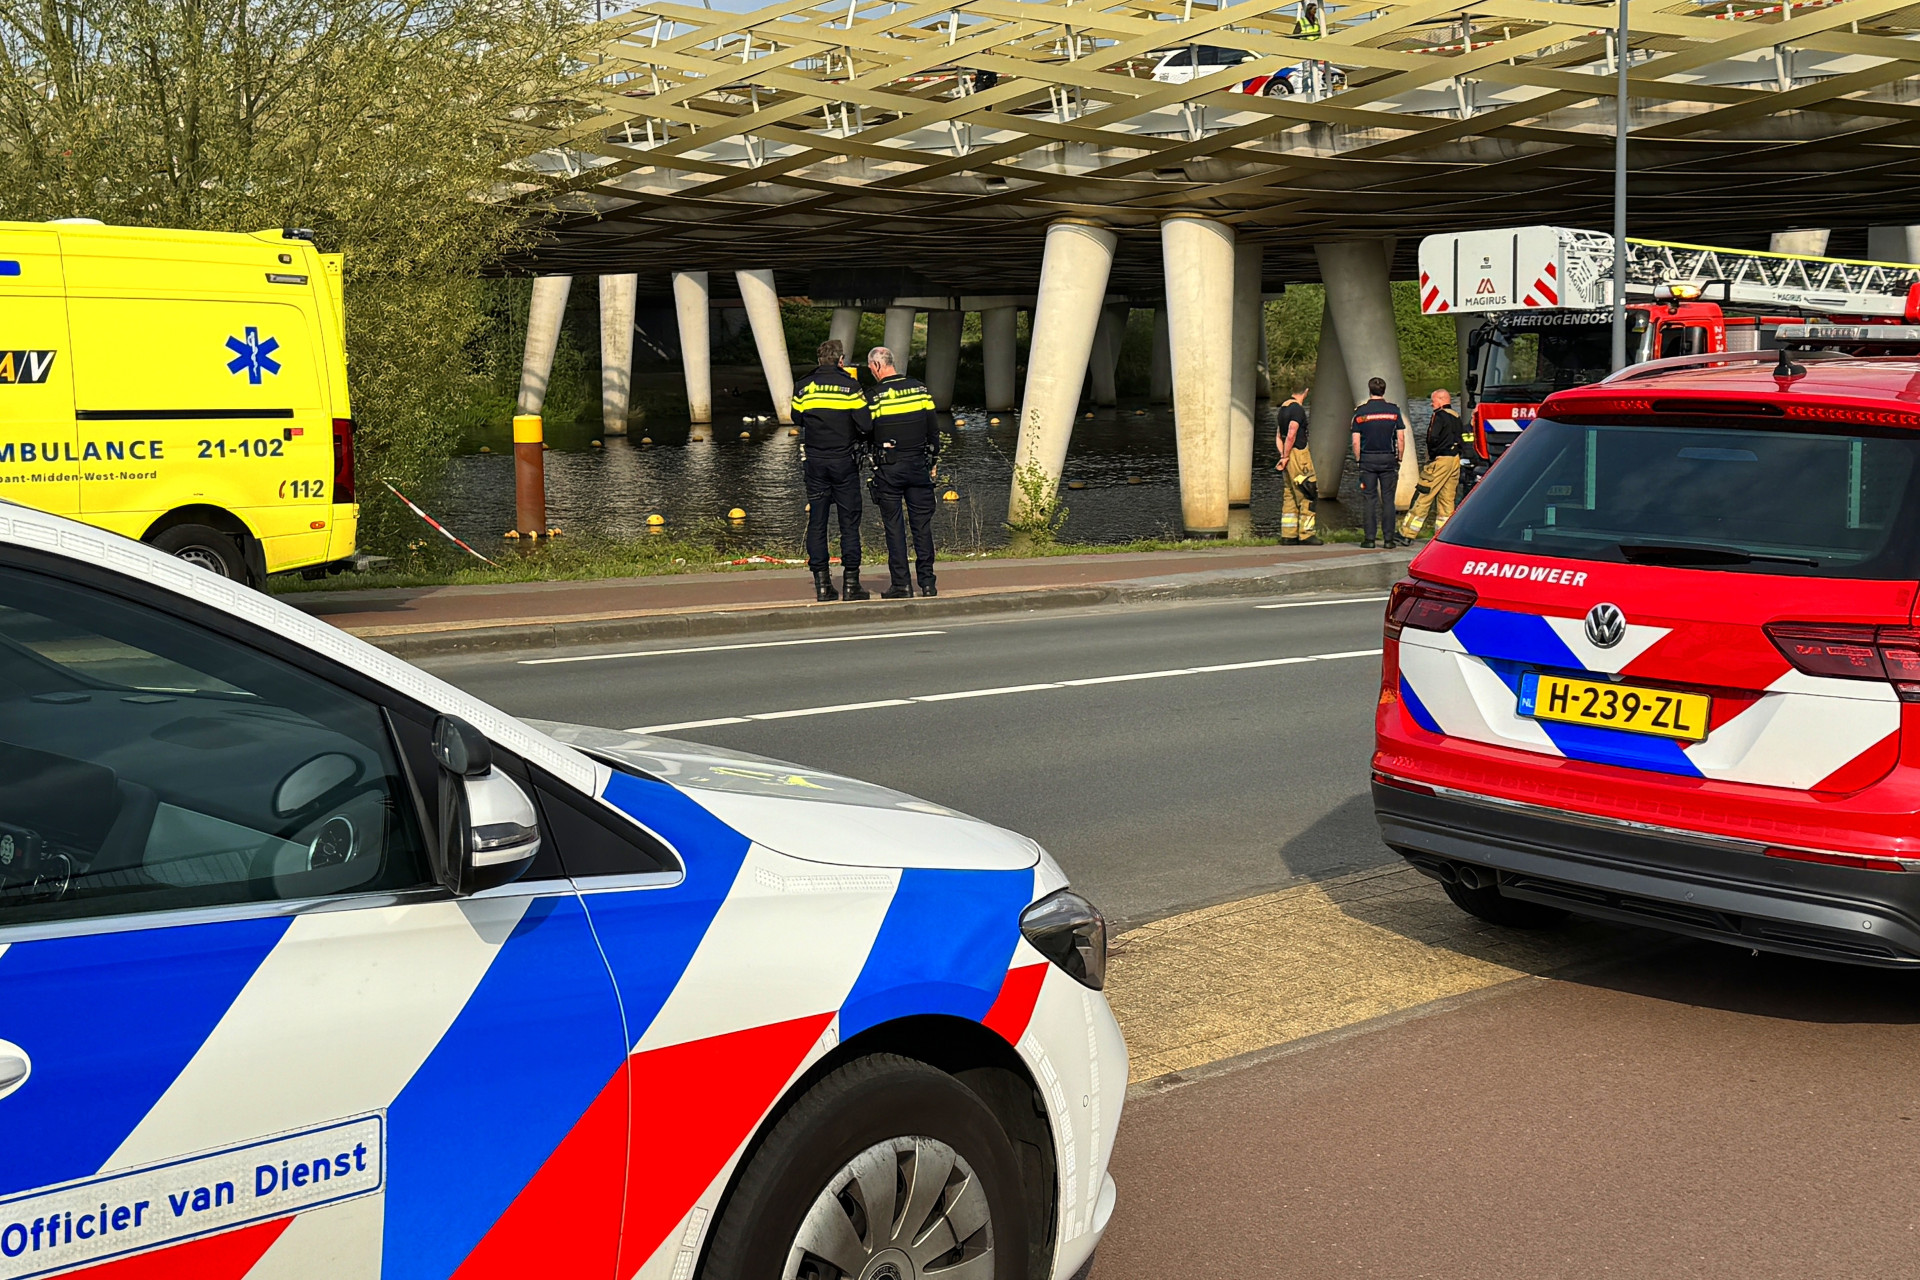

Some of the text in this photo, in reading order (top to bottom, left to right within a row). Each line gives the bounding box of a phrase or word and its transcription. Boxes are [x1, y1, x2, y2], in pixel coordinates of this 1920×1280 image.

[1465, 295, 1507, 307] MAGIRUS
[1500, 311, 1628, 328] 's-HERTOGENBOSC
[197, 438, 284, 459] 21-102
[1461, 560, 1588, 587] BRANDWEER
[1521, 682, 1690, 731] NL H-239-ZL
[1, 1142, 367, 1258] Officier van Dienst
